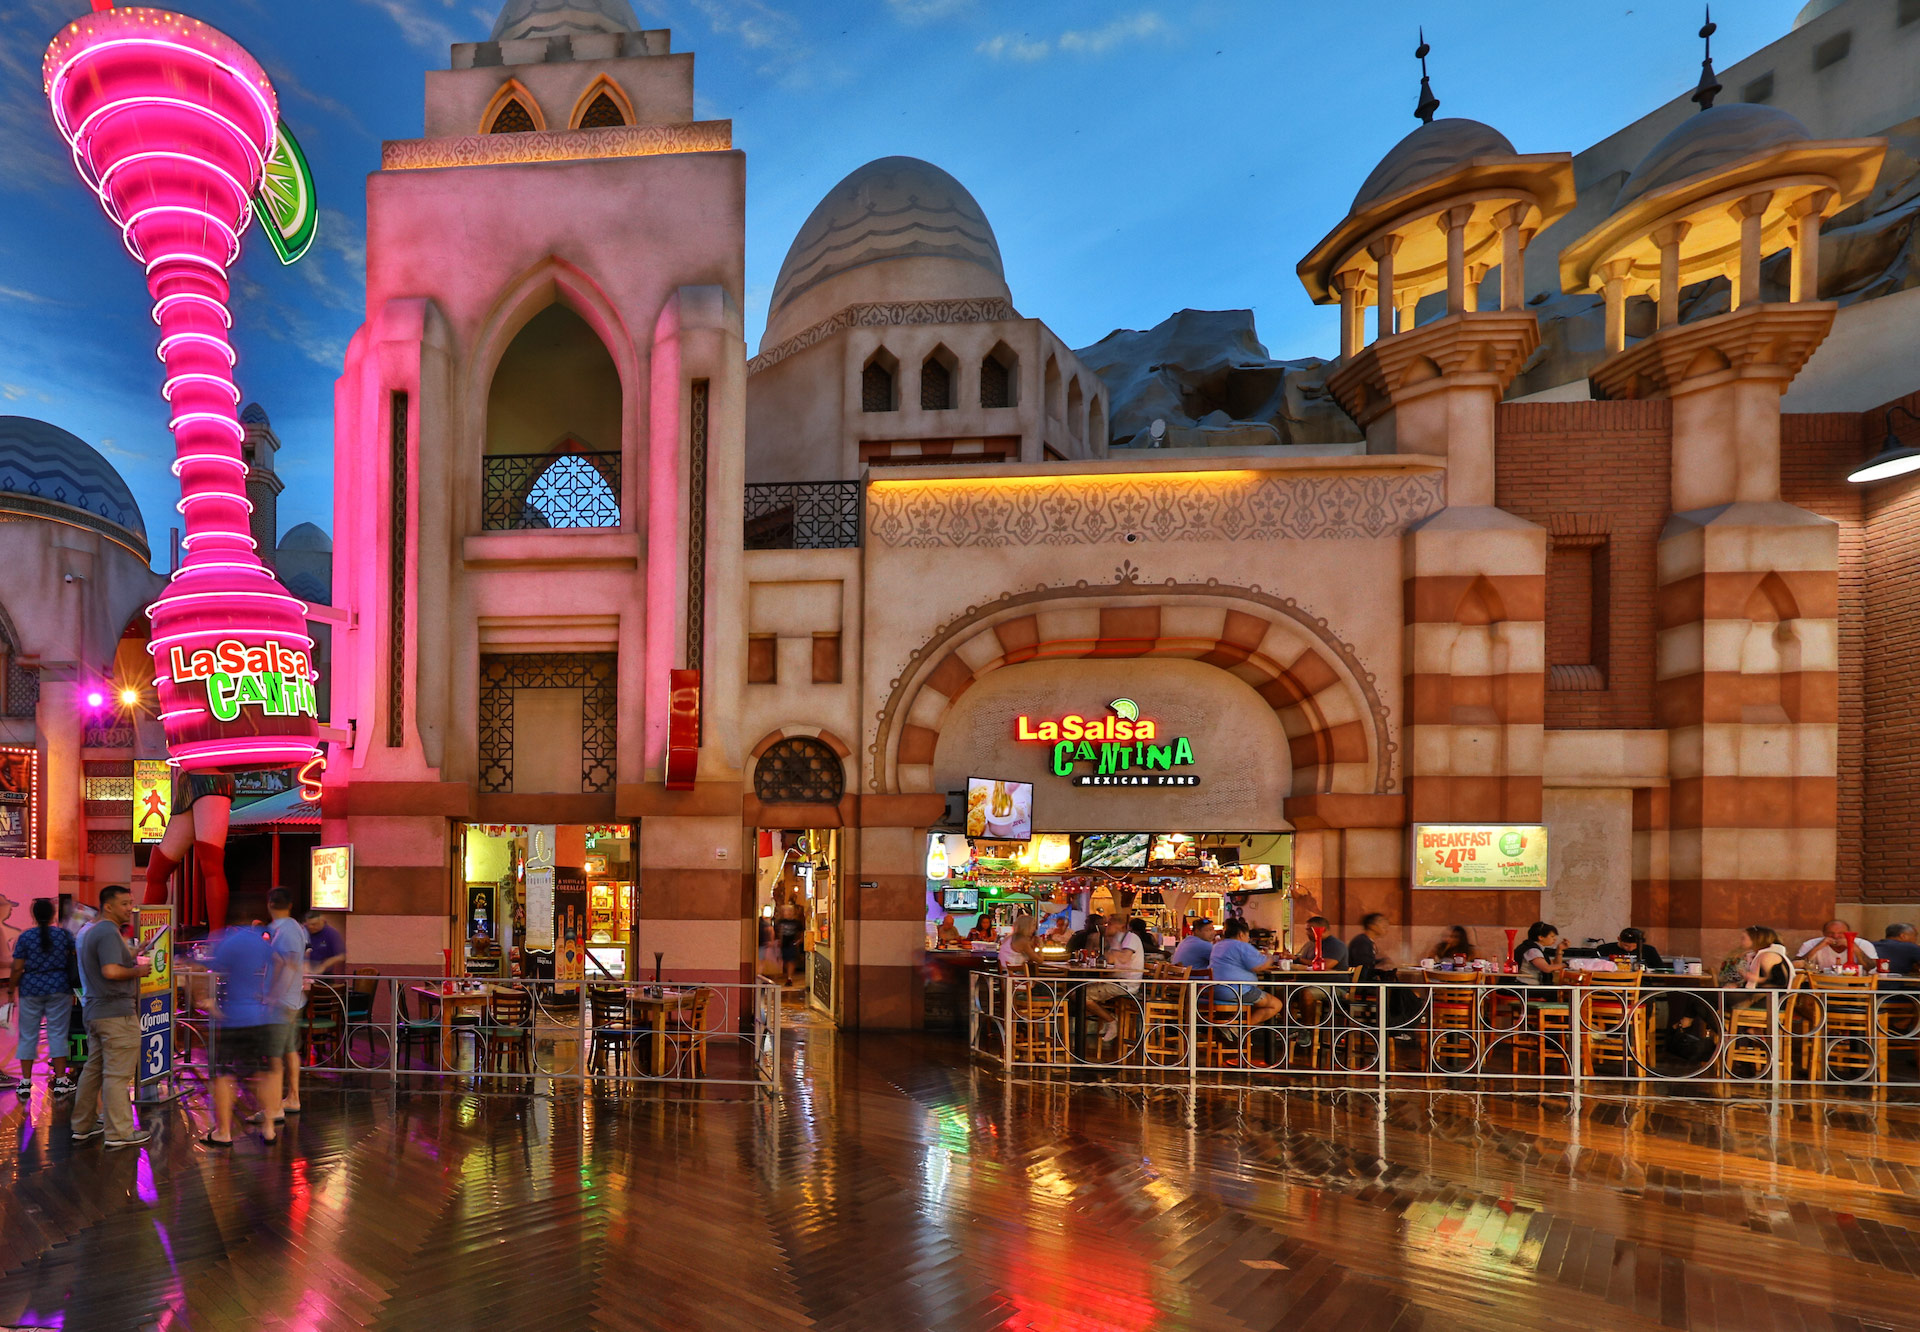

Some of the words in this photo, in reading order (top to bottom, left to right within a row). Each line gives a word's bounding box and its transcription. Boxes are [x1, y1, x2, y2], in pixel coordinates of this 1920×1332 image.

[1053, 736, 1196, 777] CANTINA
[138, 761, 159, 771] ALL
[141, 779, 158, 789] UP
[1081, 776, 1150, 785] MEXICAN
[1157, 776, 1195, 785] FARE
[1422, 831, 1493, 848] BREAKFAST
[140, 912, 169, 927] BREAKFAST
[140, 1012, 170, 1033] Corona
